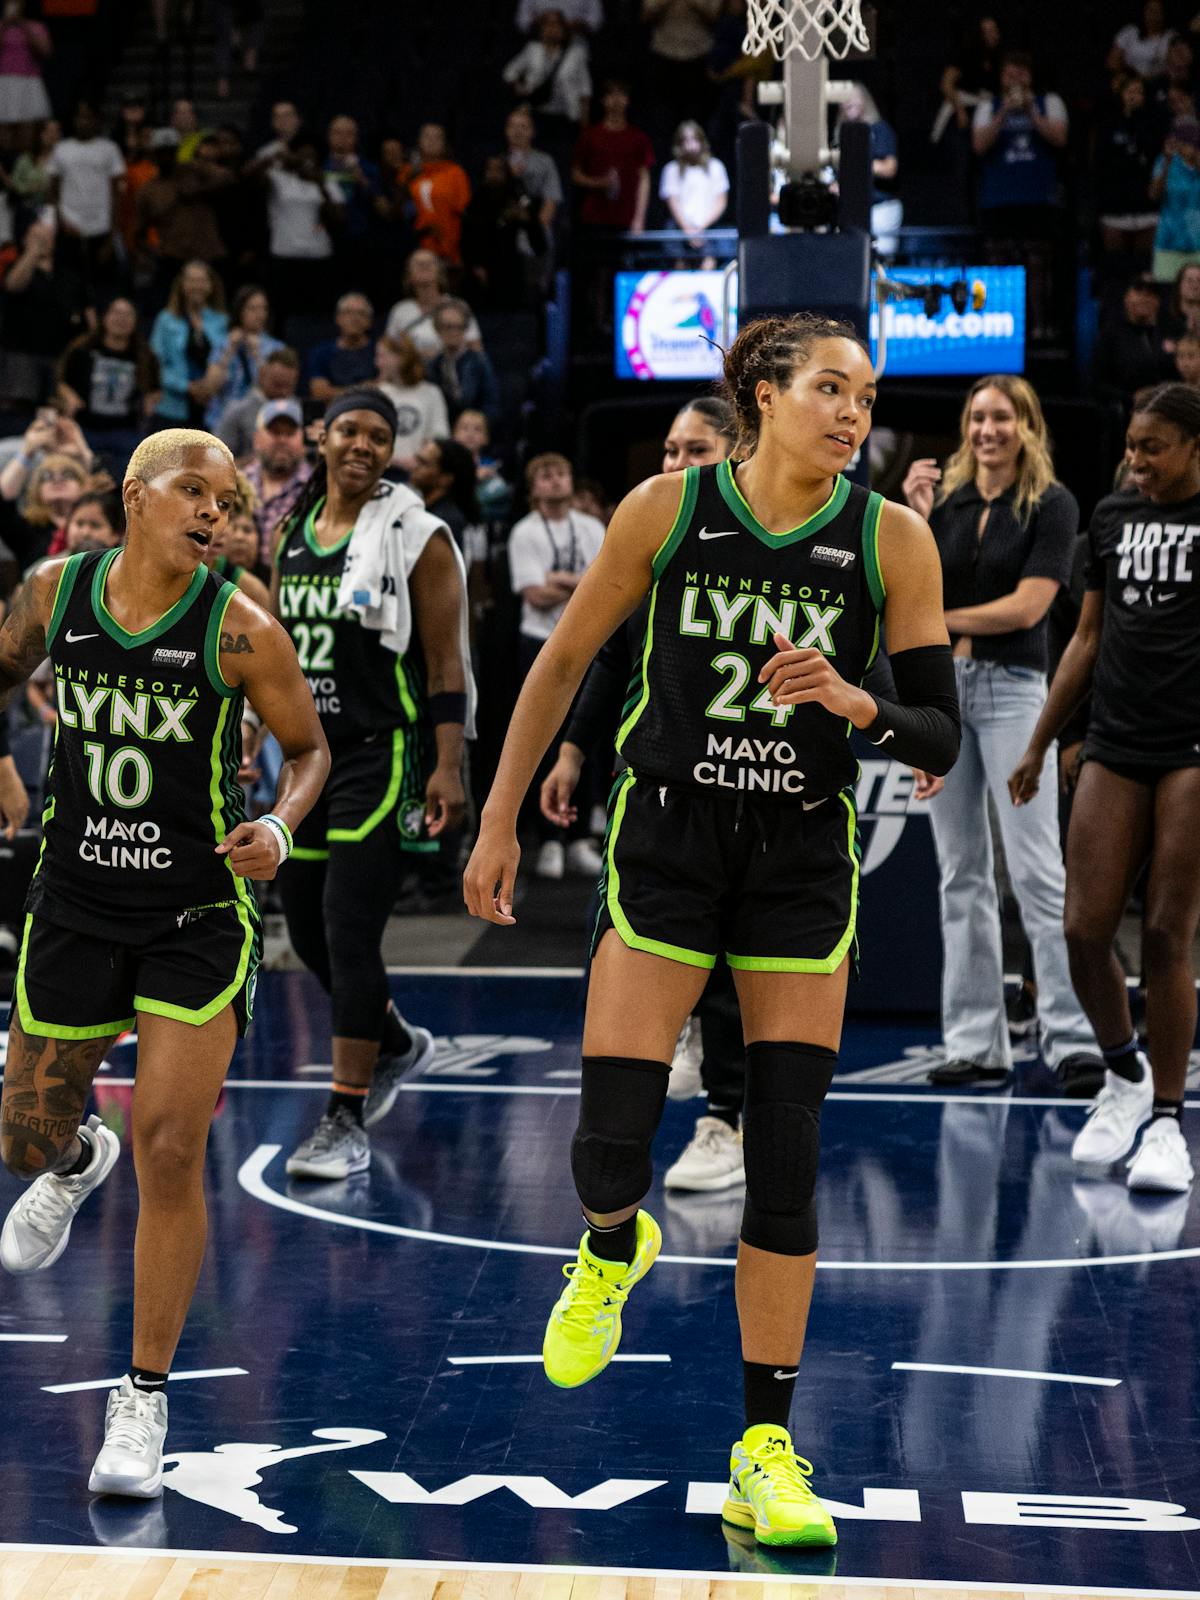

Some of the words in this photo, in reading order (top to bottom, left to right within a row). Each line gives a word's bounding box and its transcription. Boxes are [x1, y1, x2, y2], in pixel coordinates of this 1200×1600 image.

[812, 545, 856, 561] FEDERATED
[1115, 521, 1200, 582] VOTE
[685, 571, 845, 606] MINNESOTA
[679, 586, 844, 656] LYNX
[154, 648, 197, 660] FEDERATED
[293, 623, 334, 671] 22
[55, 663, 200, 698] MINNESOTA
[307, 677, 337, 695] YO
[56, 676, 198, 742] LYNX
[706, 733, 797, 764] MAYO
[83, 740, 153, 809] 10
[692, 761, 806, 793] CLINIC
[84, 815, 161, 843] MAYO
[78, 839, 173, 870] CLINIC
